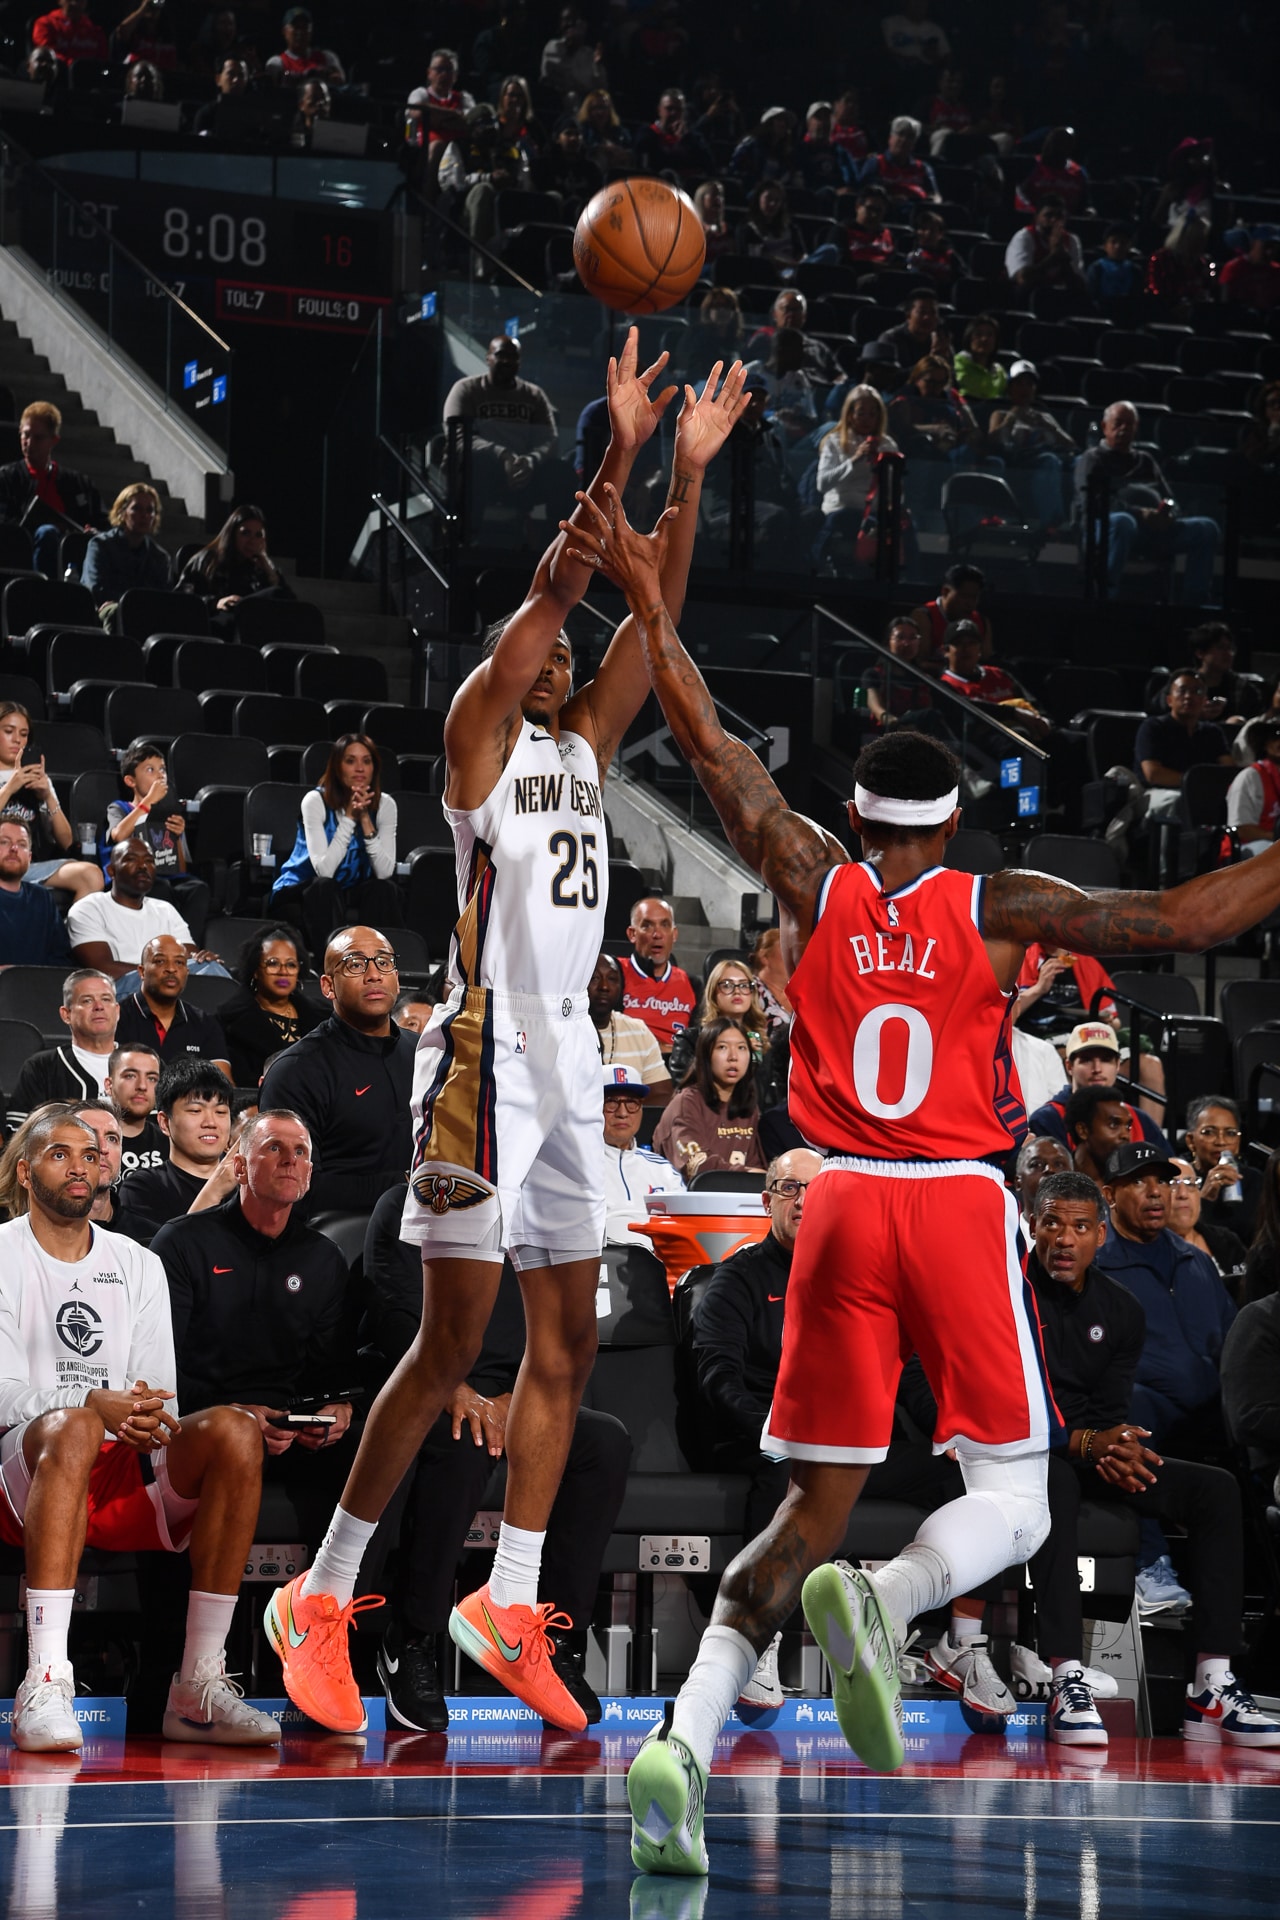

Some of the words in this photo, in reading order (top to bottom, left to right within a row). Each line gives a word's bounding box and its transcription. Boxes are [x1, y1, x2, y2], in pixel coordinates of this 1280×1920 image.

[163, 207, 267, 267] 8:08
[322, 233, 353, 267] 16
[514, 773, 564, 815] NEW
[547, 829, 599, 910] 25
[849, 937, 937, 980] BEAL
[852, 1003, 934, 1120] 0
[121, 1150, 164, 1169] OSS
[92, 1277, 124, 1286] RWANDA
[99, 1271, 118, 1279] VISIT
[56, 1361, 66, 1372] LOS
[448, 1709, 469, 1721] SER
[626, 1709, 664, 1721] KAISER
[1003, 1714, 1038, 1726] KAISER
